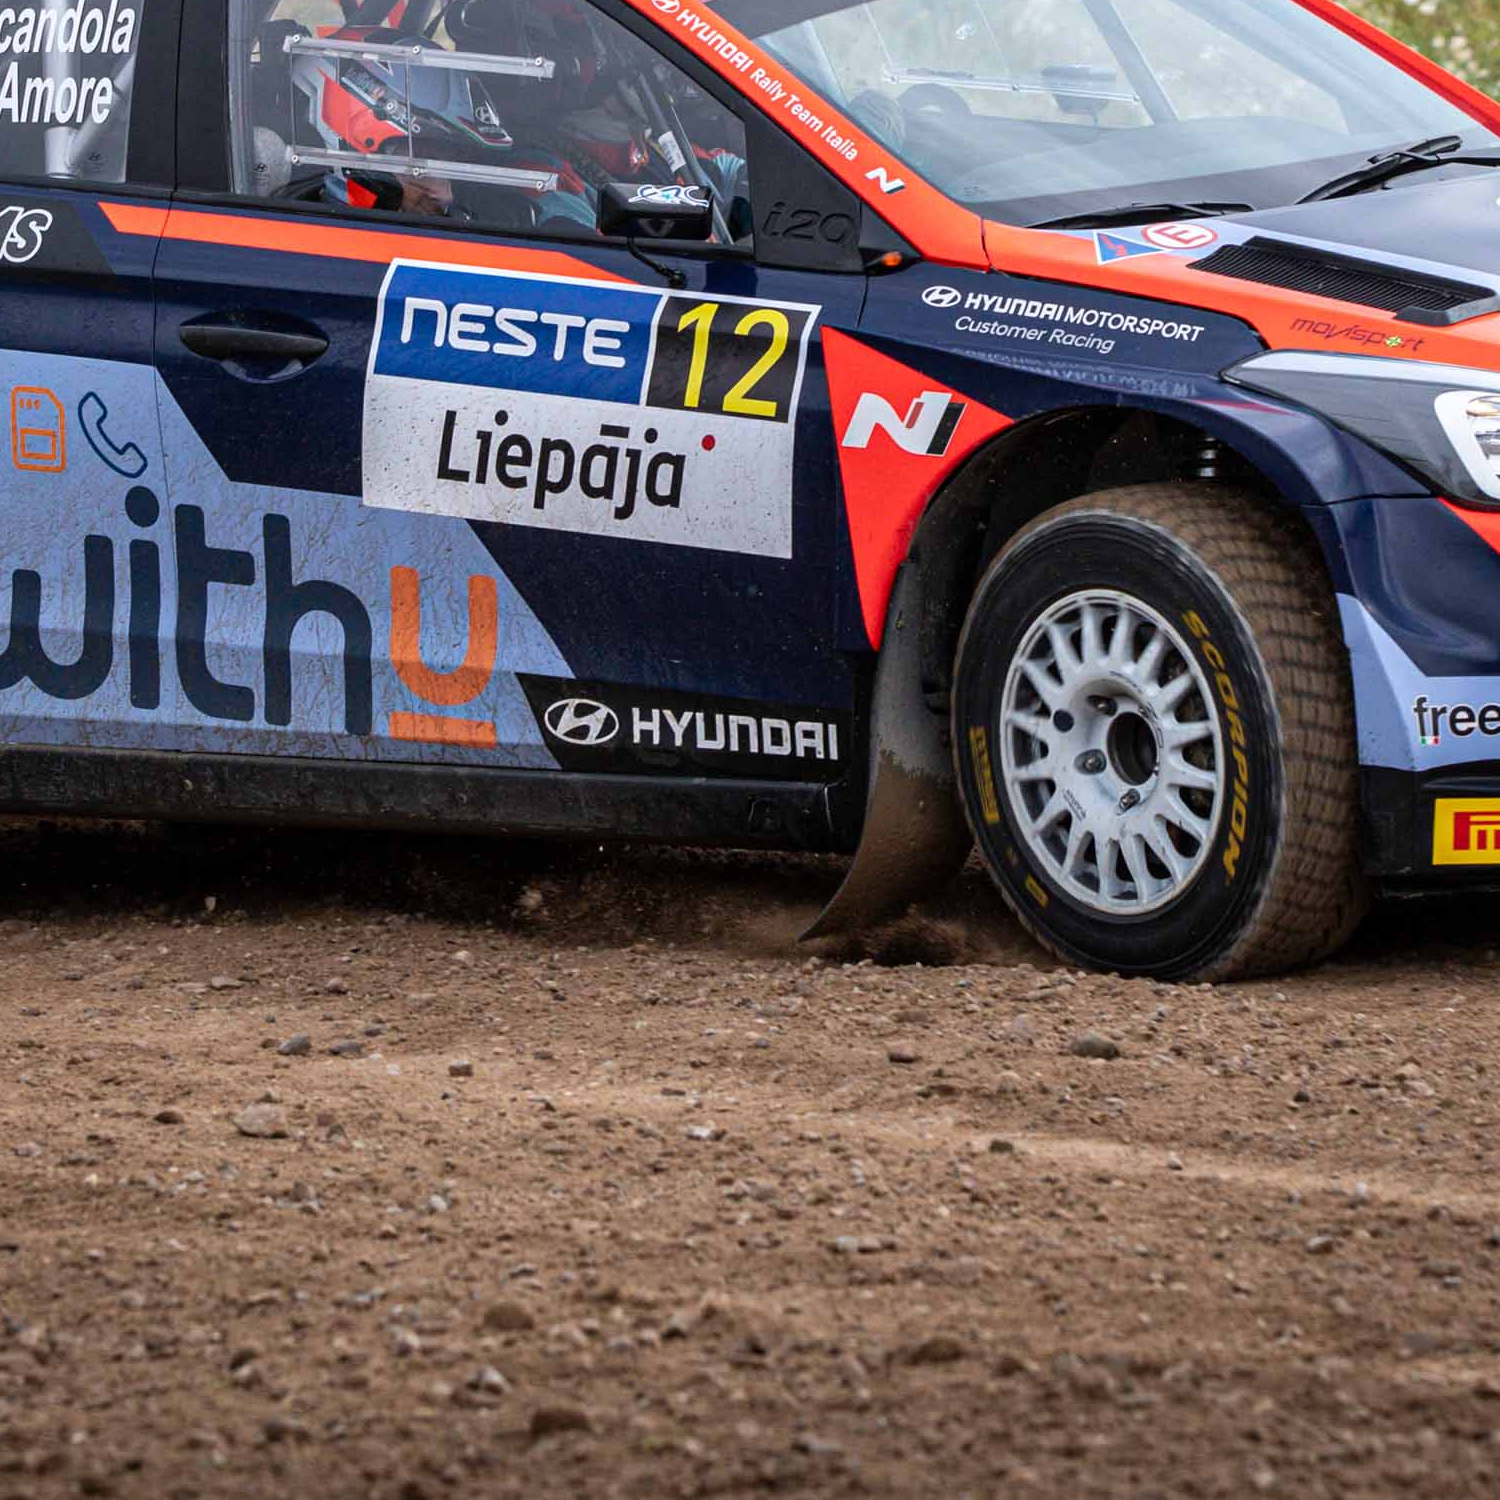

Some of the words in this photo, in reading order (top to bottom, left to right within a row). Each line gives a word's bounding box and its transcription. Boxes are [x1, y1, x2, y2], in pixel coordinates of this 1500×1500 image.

[676, 9, 753, 72] HYUNDAI
[750, 68, 787, 101] Rally
[784, 95, 823, 131] Team
[822, 126, 858, 161] Italia
[762, 201, 855, 242] i20
[1153, 225, 1204, 245] E
[955, 316, 1047, 341] Customer
[1049, 328, 1116, 354] Racing
[964, 292, 1065, 322] HYUNDAI
[1063, 307, 1205, 343] MOTORSPORT
[400, 297, 631, 368] NESTE
[676, 302, 790, 418] 12
[436, 409, 687, 520] Liepāja
[631, 706, 839, 761] HYUNDAI
[1181, 610, 1249, 885] SCORPION
